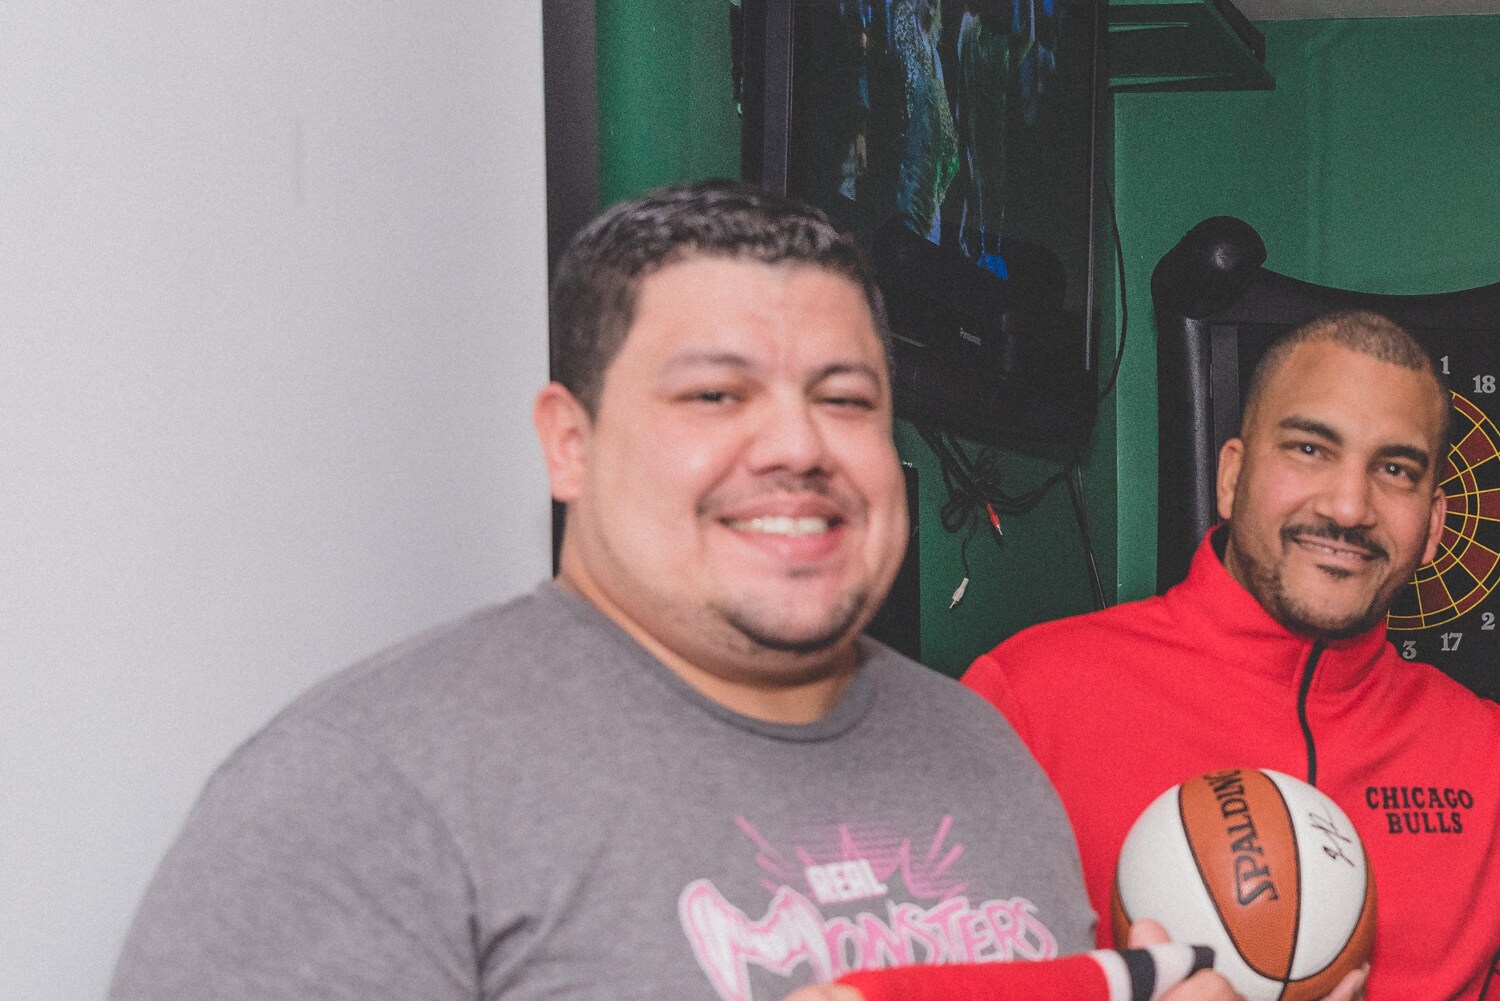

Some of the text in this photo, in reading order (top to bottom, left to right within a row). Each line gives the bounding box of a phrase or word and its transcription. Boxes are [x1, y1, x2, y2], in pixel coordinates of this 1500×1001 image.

[1440, 355, 1450, 375] 1
[1472, 375, 1496, 394] 18
[1480, 612, 1496, 631] 2
[1402, 640, 1417, 660] 3
[1440, 632, 1463, 652] 17
[1365, 786, 1474, 809] CHICAGO
[1386, 812, 1464, 834] BULLS
